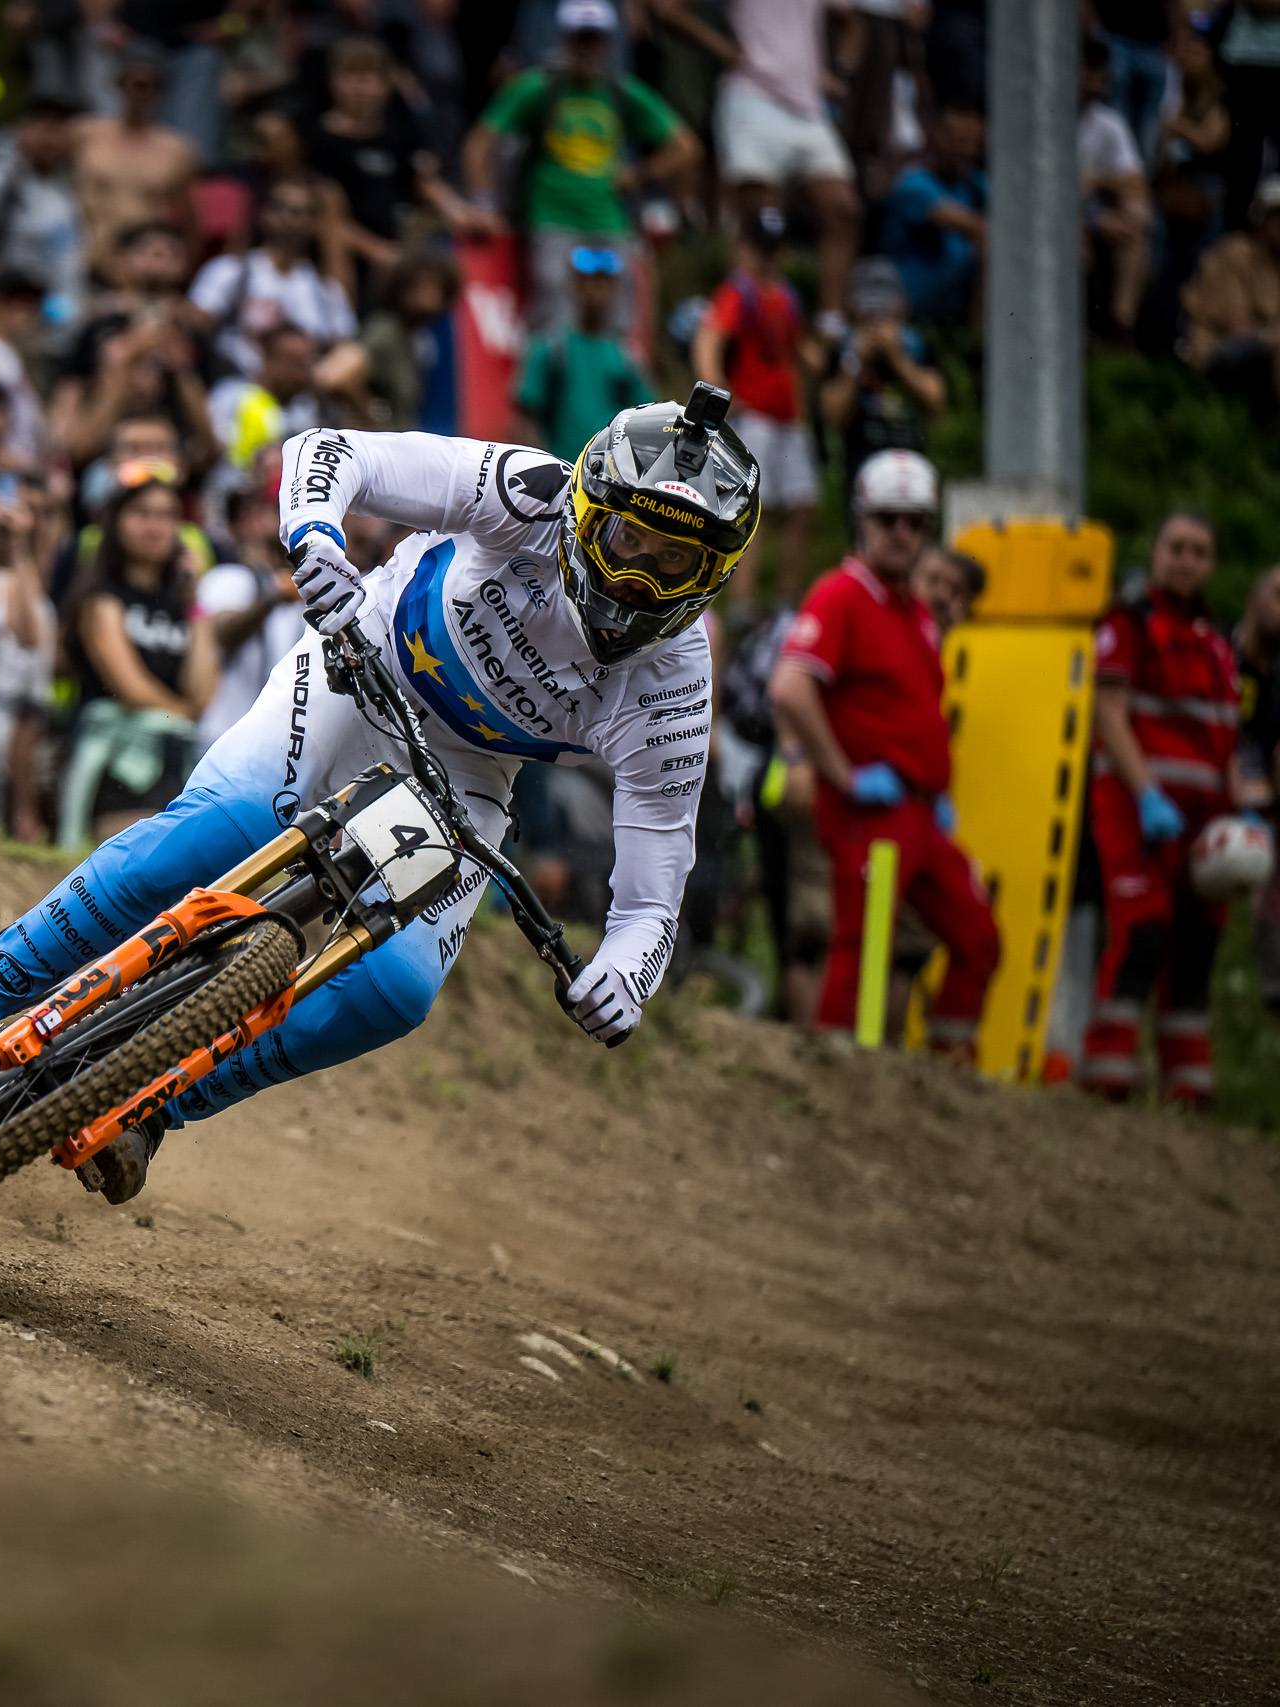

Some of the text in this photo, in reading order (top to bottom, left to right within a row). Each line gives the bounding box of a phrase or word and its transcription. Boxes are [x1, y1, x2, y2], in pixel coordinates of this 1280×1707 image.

[290, 474, 304, 511] bikes
[474, 443, 497, 505] ENDURA
[664, 482, 702, 503] BELL
[577, 507, 593, 533] OAKLEY
[629, 493, 706, 530] SCHLADMING
[526, 578, 550, 611] UEC
[479, 578, 570, 703] Continental
[451, 597, 554, 736] Atherton
[570, 660, 604, 703] ENDURA
[638, 679, 703, 709] Continental
[284, 652, 311, 788] ENDURA
[645, 725, 705, 748] RENISHAW
[420, 793, 433, 811] VAL
[432, 809, 442, 821] DI
[439, 820, 456, 847] SOLE
[389, 824, 431, 860] 4
[45, 897, 100, 961] Atherton
[69, 875, 120, 940] Continental
[16, 923, 57, 979] ENDURA
